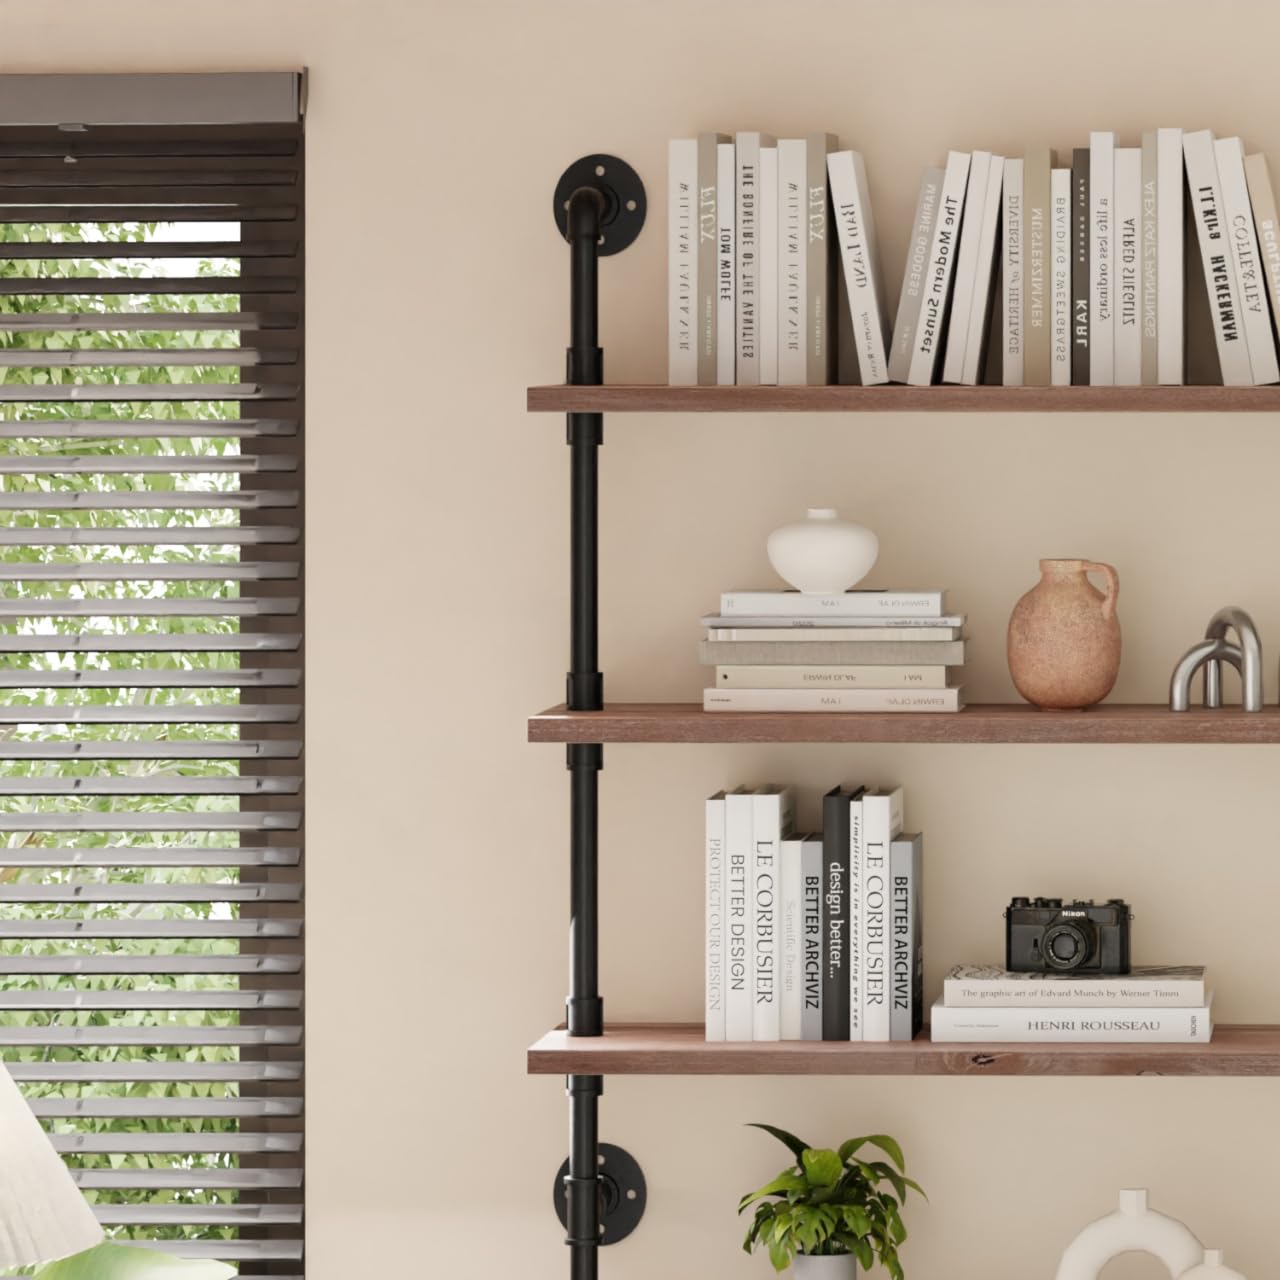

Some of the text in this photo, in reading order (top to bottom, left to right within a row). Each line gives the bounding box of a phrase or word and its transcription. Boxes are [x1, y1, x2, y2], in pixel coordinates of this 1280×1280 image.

[852, 815, 860, 878] simplicity
[853, 882, 860, 893] is
[709, 839, 720, 1010] PROTECT OUR DESIGN
[731, 854, 744, 990] BETTER DESIGN
[756, 840, 774, 1004] LE CORBUSIER
[806, 876, 819, 1009] BETTER ARCHVIZ
[826, 862, 844, 980] design better...
[852, 915, 860, 982] everything
[853, 898, 860, 910] in
[866, 842, 884, 1006] LE CORBUSIER
[894, 876, 908, 1010] BETTER ARCHVIZ
[854, 986, 860, 1004] we
[980, 990, 1012, 999] graphic
[1106, 990, 1117, 999] by
[1028, 1021, 1160, 1031] HENRI ROUSSEAU
